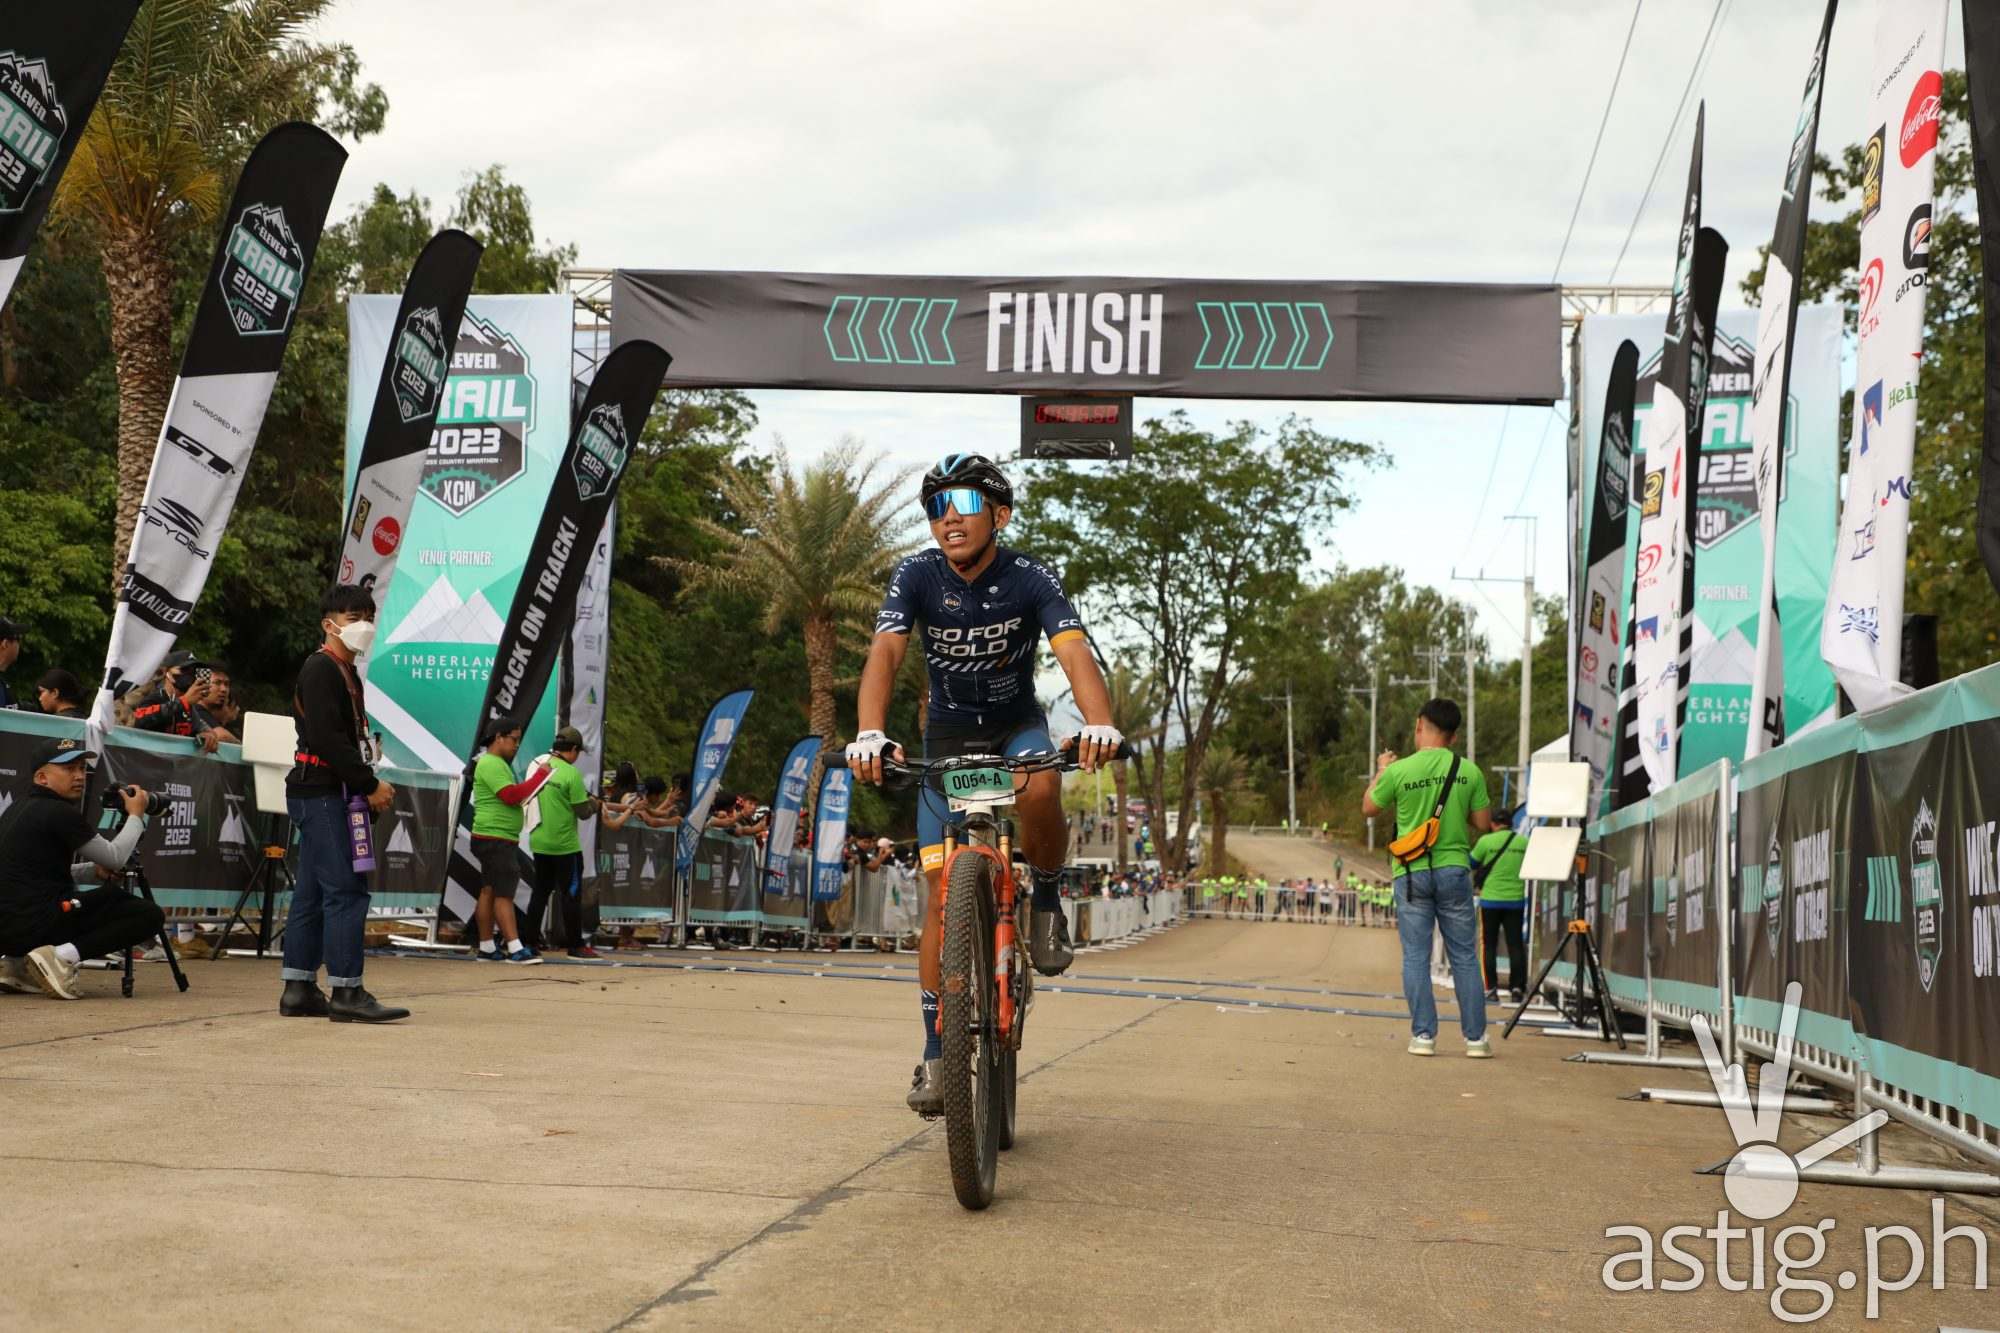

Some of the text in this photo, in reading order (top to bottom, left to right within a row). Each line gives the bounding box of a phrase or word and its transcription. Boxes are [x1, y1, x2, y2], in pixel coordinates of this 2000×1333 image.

[0, 144, 27, 184] 23
[232, 226, 296, 299] TRAIL
[232, 266, 278, 311] 2023
[235, 306, 255, 330] XCM
[986, 292, 1163, 376] FINISH
[401, 331, 440, 384] TRAIL
[401, 365, 427, 398] 2023
[192, 399, 231, 430] SPONSORED
[582, 422, 619, 470] TRAIL
[582, 451, 606, 479] 2023
[443, 480, 476, 507] XCM
[1695, 509, 1726, 540] CM
[418, 549, 448, 566] VENUE
[495, 641, 532, 711] BACK
[520, 603, 547, 643] ON
[534, 515, 580, 604] TRACK!
[1057, 618, 1081, 629] CC
[927, 616, 1023, 641] GO FOR
[391, 654, 494, 668] TIMBERLAN
[932, 639, 1009, 658] GOLD
[411, 669, 489, 681] HEIGHTS
[952, 772, 1003, 791] 0054-A
[1404, 778, 1432, 791] RACE
[164, 828, 191, 846] 2023
